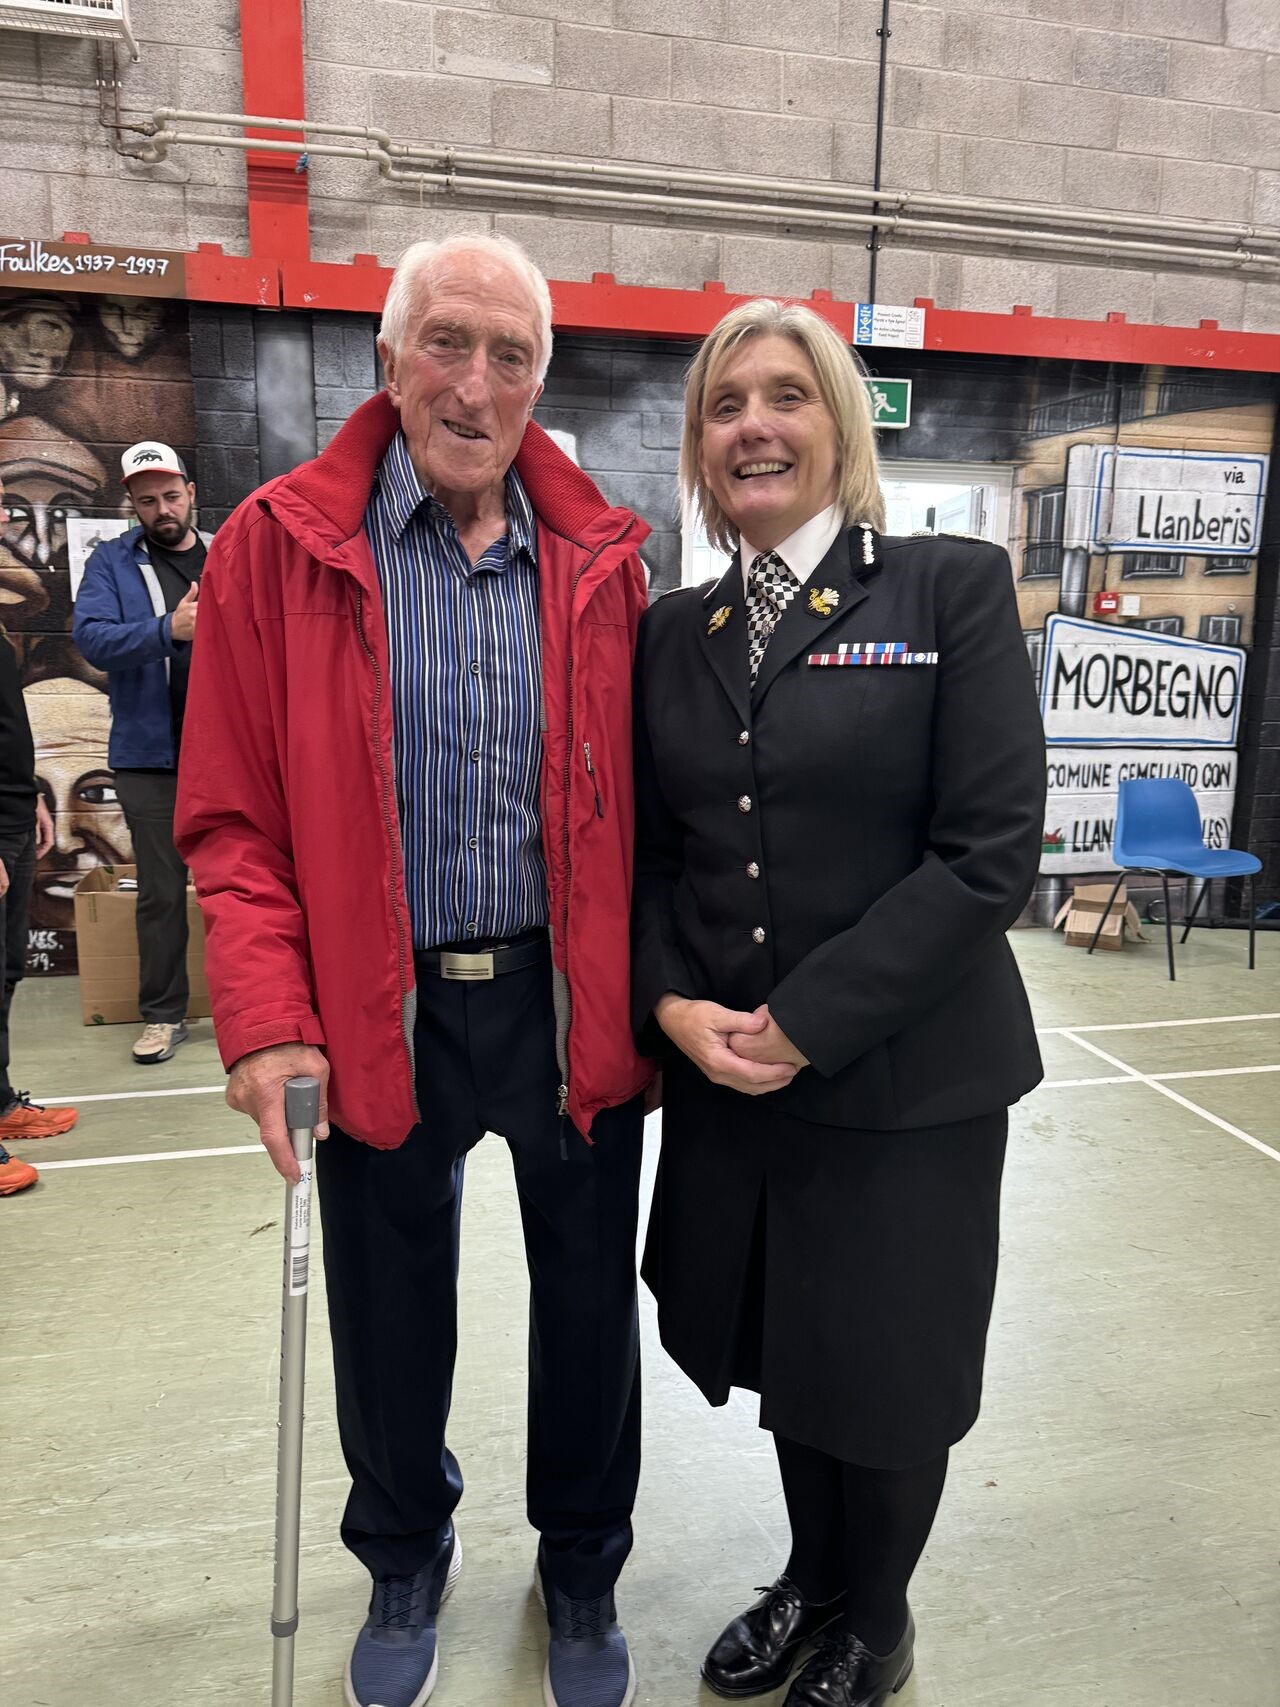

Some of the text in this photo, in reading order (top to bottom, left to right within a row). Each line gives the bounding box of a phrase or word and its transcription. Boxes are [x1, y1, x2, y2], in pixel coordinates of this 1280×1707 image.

[0, 241, 75, 275] Foulkes
[1224, 466, 1245, 484] via
[1137, 495, 1251, 544] Llanberis
[1051, 648, 1238, 720] MORBEGNO
[1047, 763, 1112, 789] COMUNE
[1202, 762, 1232, 789] CON
[1072, 818, 1117, 852] LLAN
